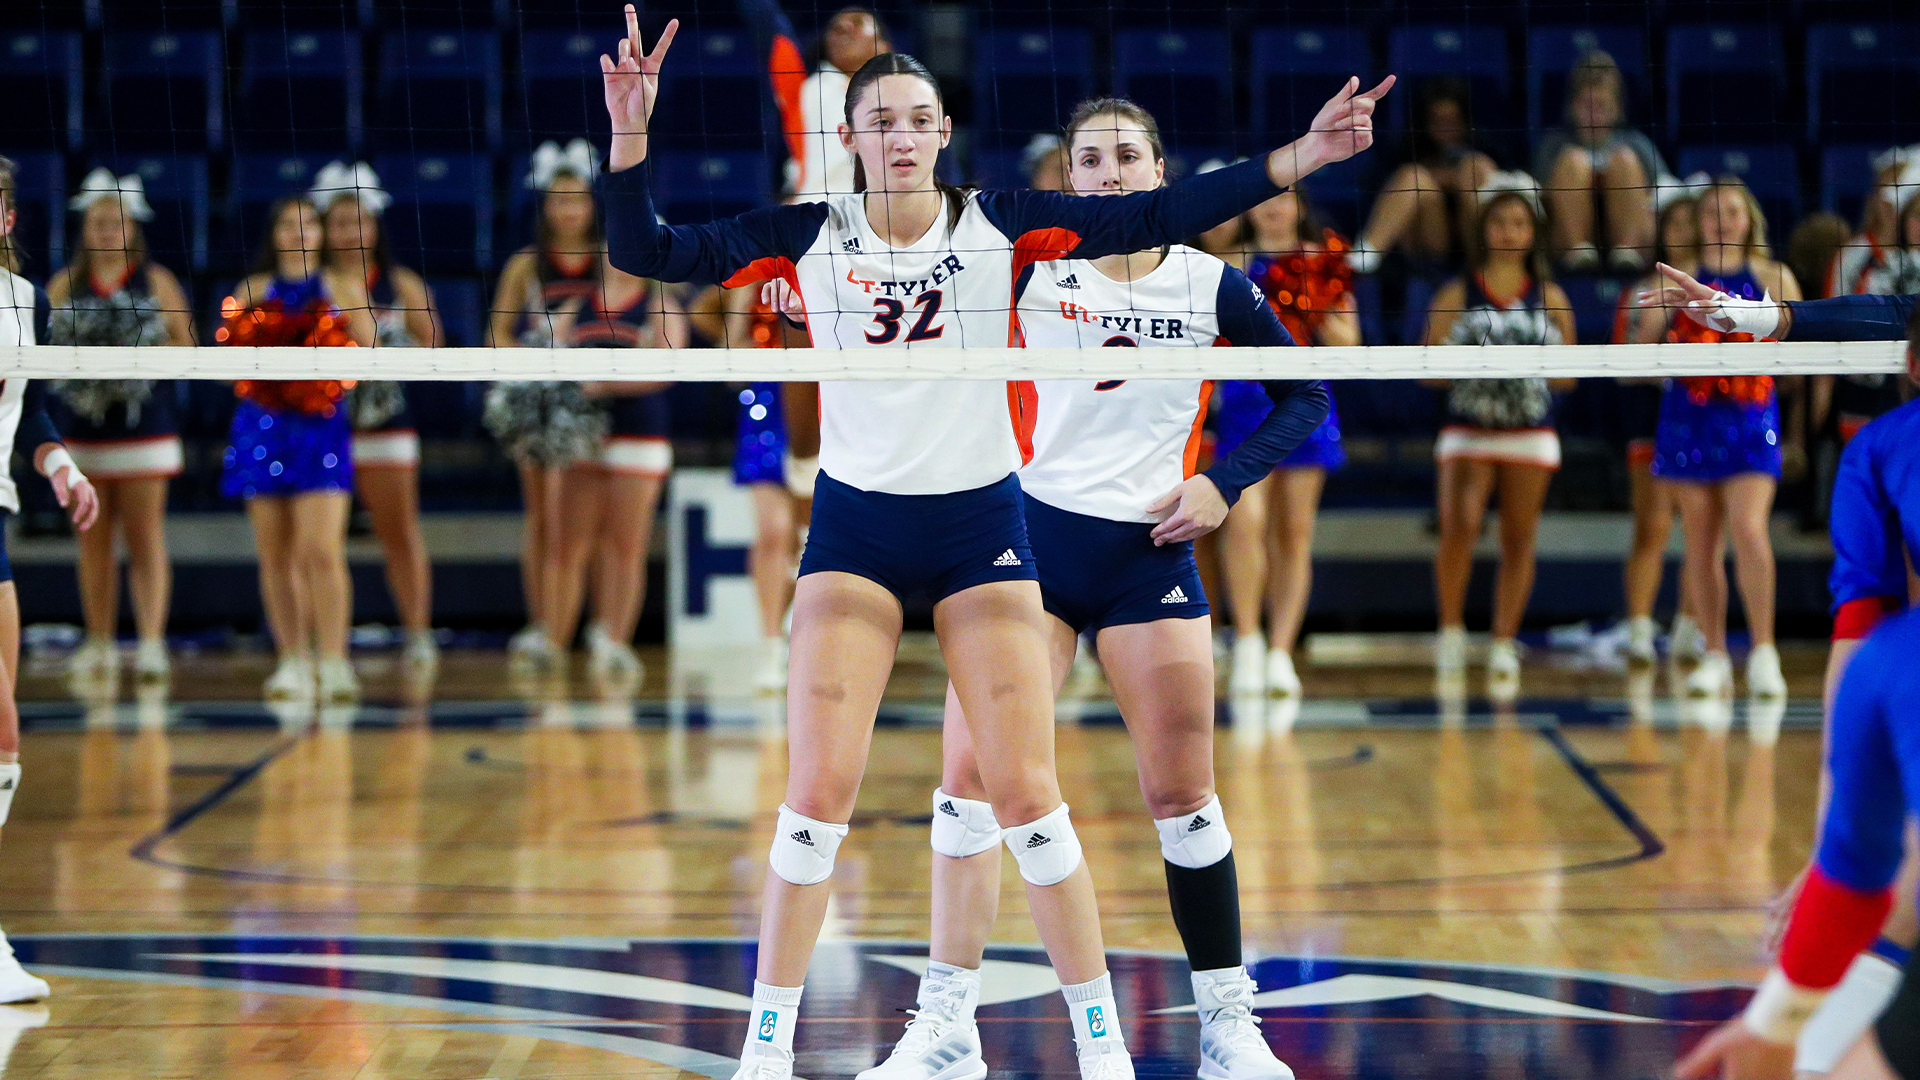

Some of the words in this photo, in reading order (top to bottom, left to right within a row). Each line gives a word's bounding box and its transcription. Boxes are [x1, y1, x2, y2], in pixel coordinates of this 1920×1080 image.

[1056, 281, 1081, 290] adidas
[864, 289, 945, 345] 32
[939, 806, 959, 818] adidas
[1188, 820, 1211, 832] adidas
[791, 834, 814, 846] adidas
[1027, 837, 1051, 848] adidas
